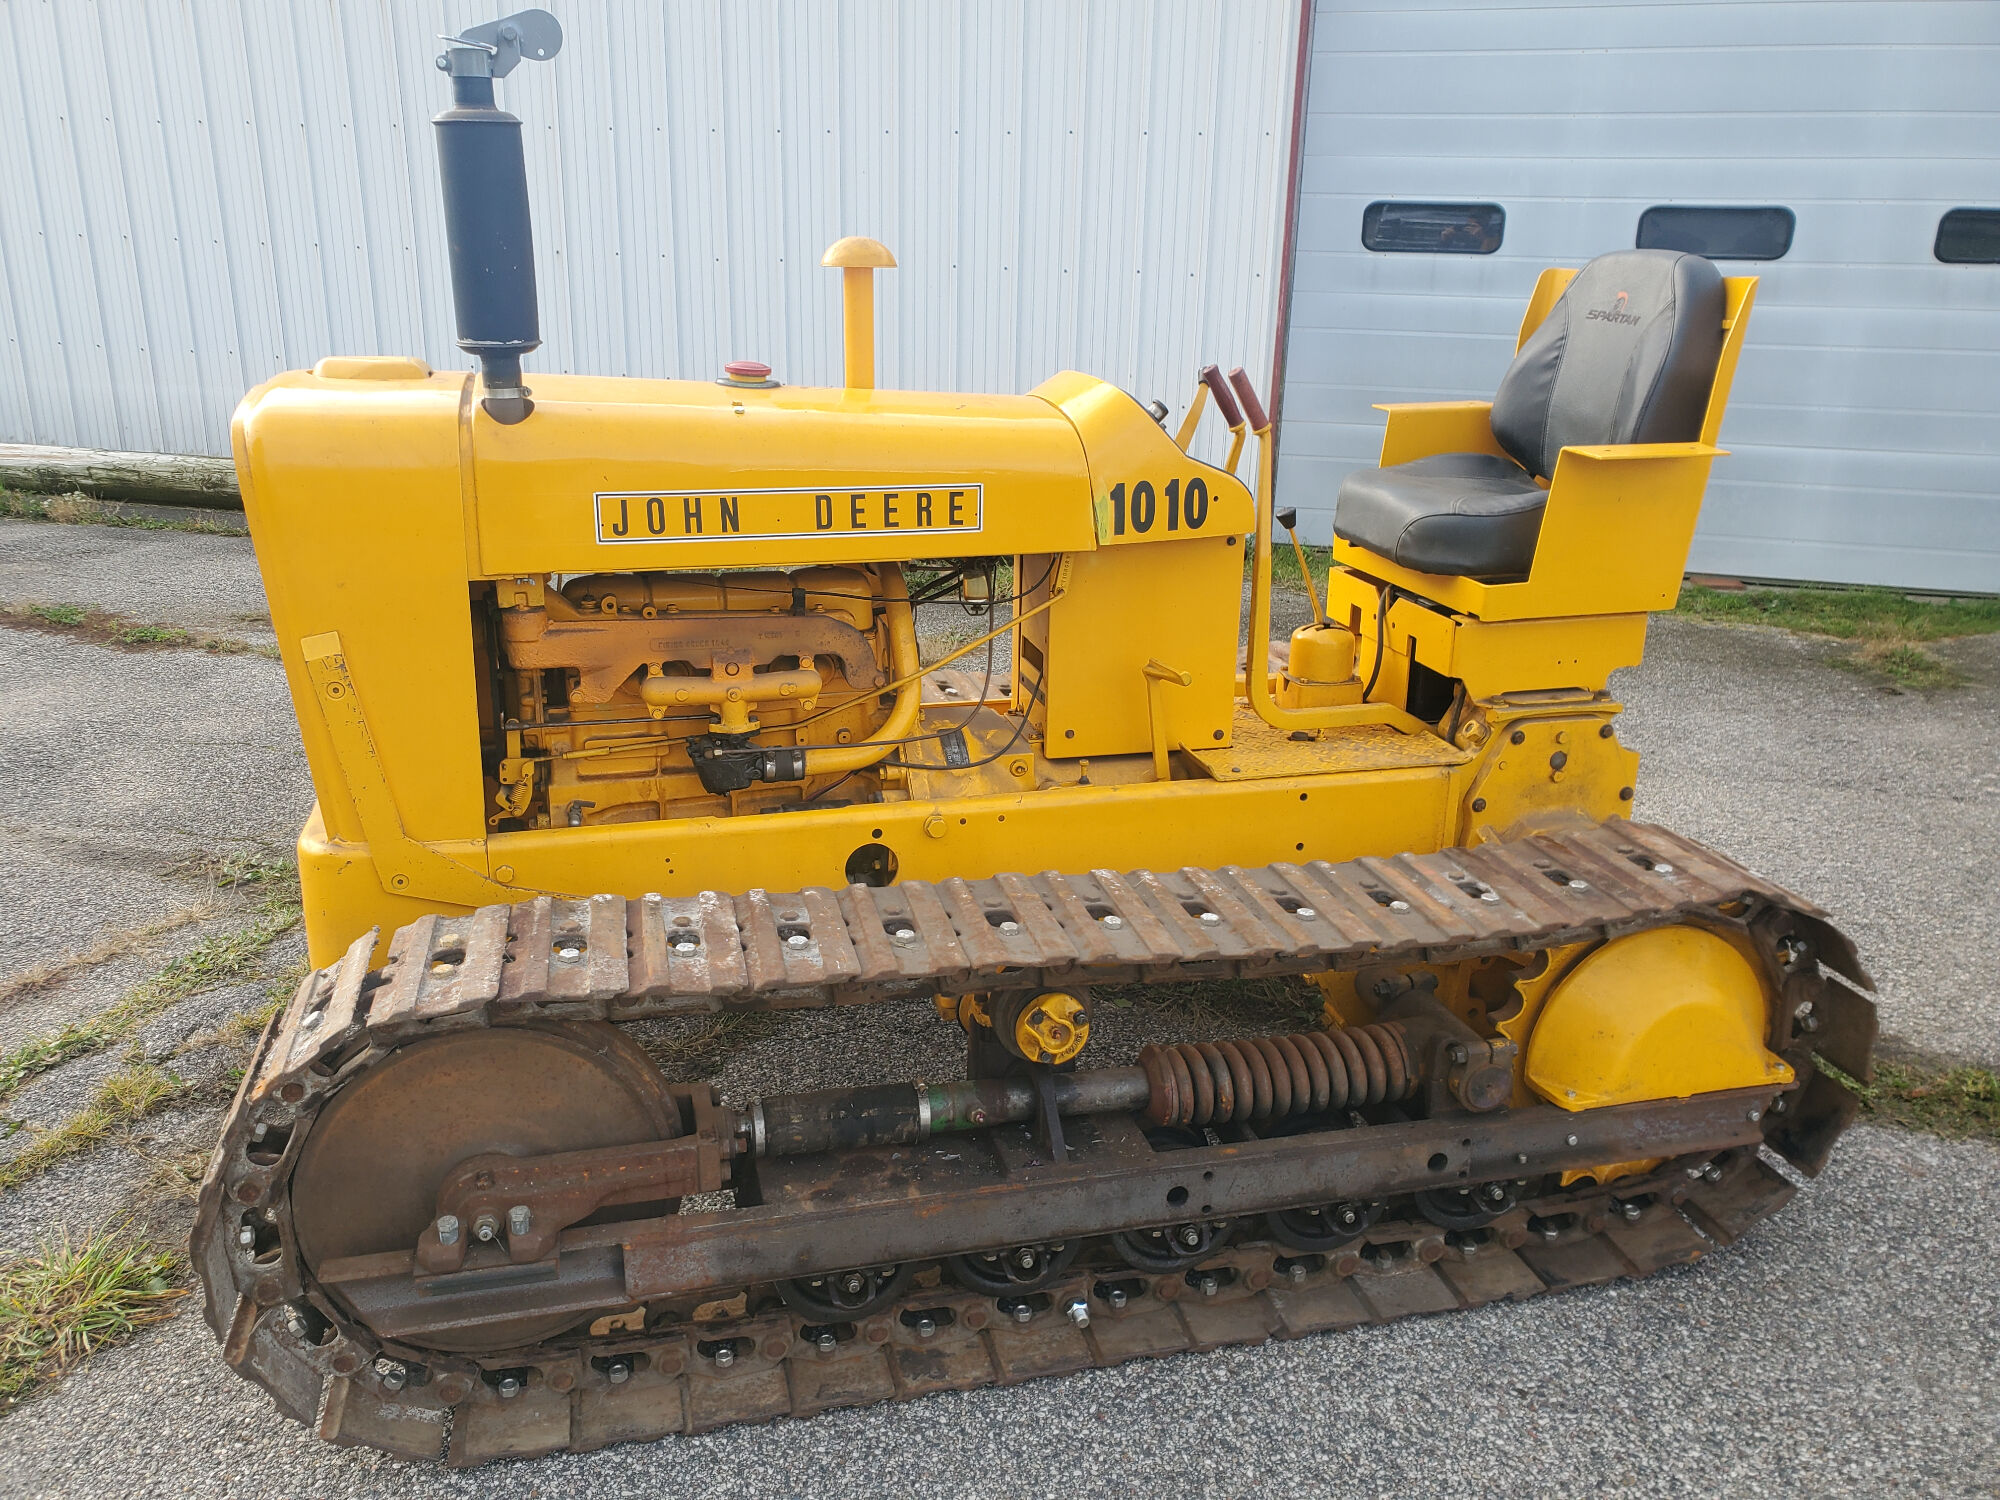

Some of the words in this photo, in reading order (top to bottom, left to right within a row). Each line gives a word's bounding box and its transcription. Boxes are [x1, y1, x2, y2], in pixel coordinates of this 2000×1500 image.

[1585, 309, 1641, 326] SPARTAN
[612, 497, 740, 536] JOHN
[815, 491, 965, 530] DEERE
[1110, 477, 1209, 536] 1010
